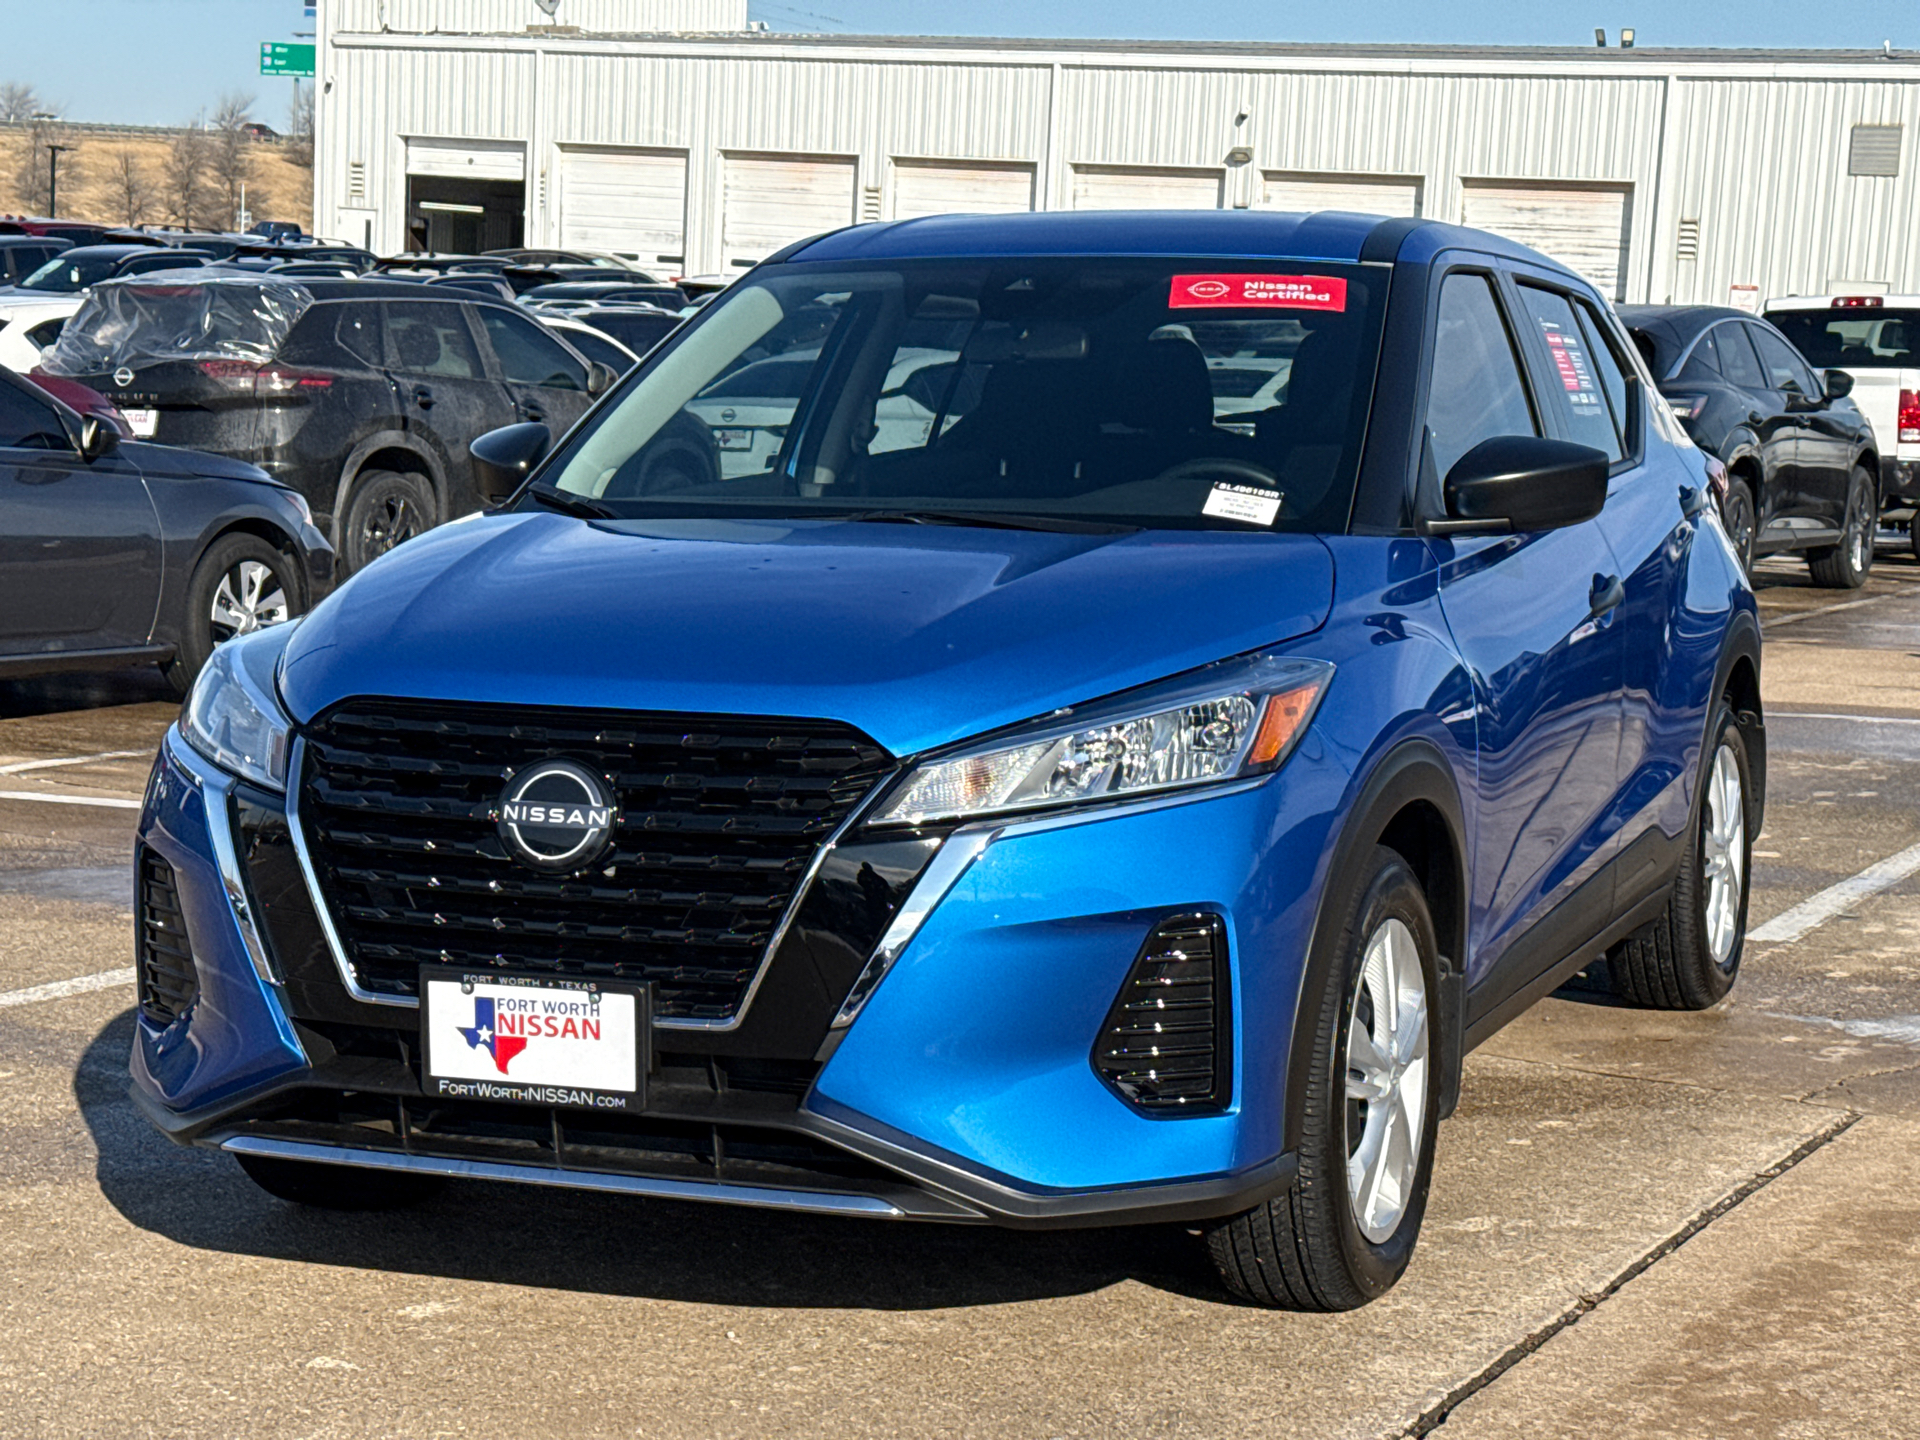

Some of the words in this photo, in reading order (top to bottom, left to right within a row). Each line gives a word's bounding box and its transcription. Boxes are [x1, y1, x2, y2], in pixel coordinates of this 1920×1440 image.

[1244, 281, 1312, 291] Nissan
[1243, 290, 1330, 301] Certified
[504, 805, 606, 825] NISSAN
[463, 974, 493, 984] FORT
[498, 976, 540, 987] WORTH
[559, 982, 597, 992] TEXAS
[498, 999, 538, 1012] FORT
[543, 1001, 600, 1017] WORTH
[498, 1014, 601, 1040] NISSAN
